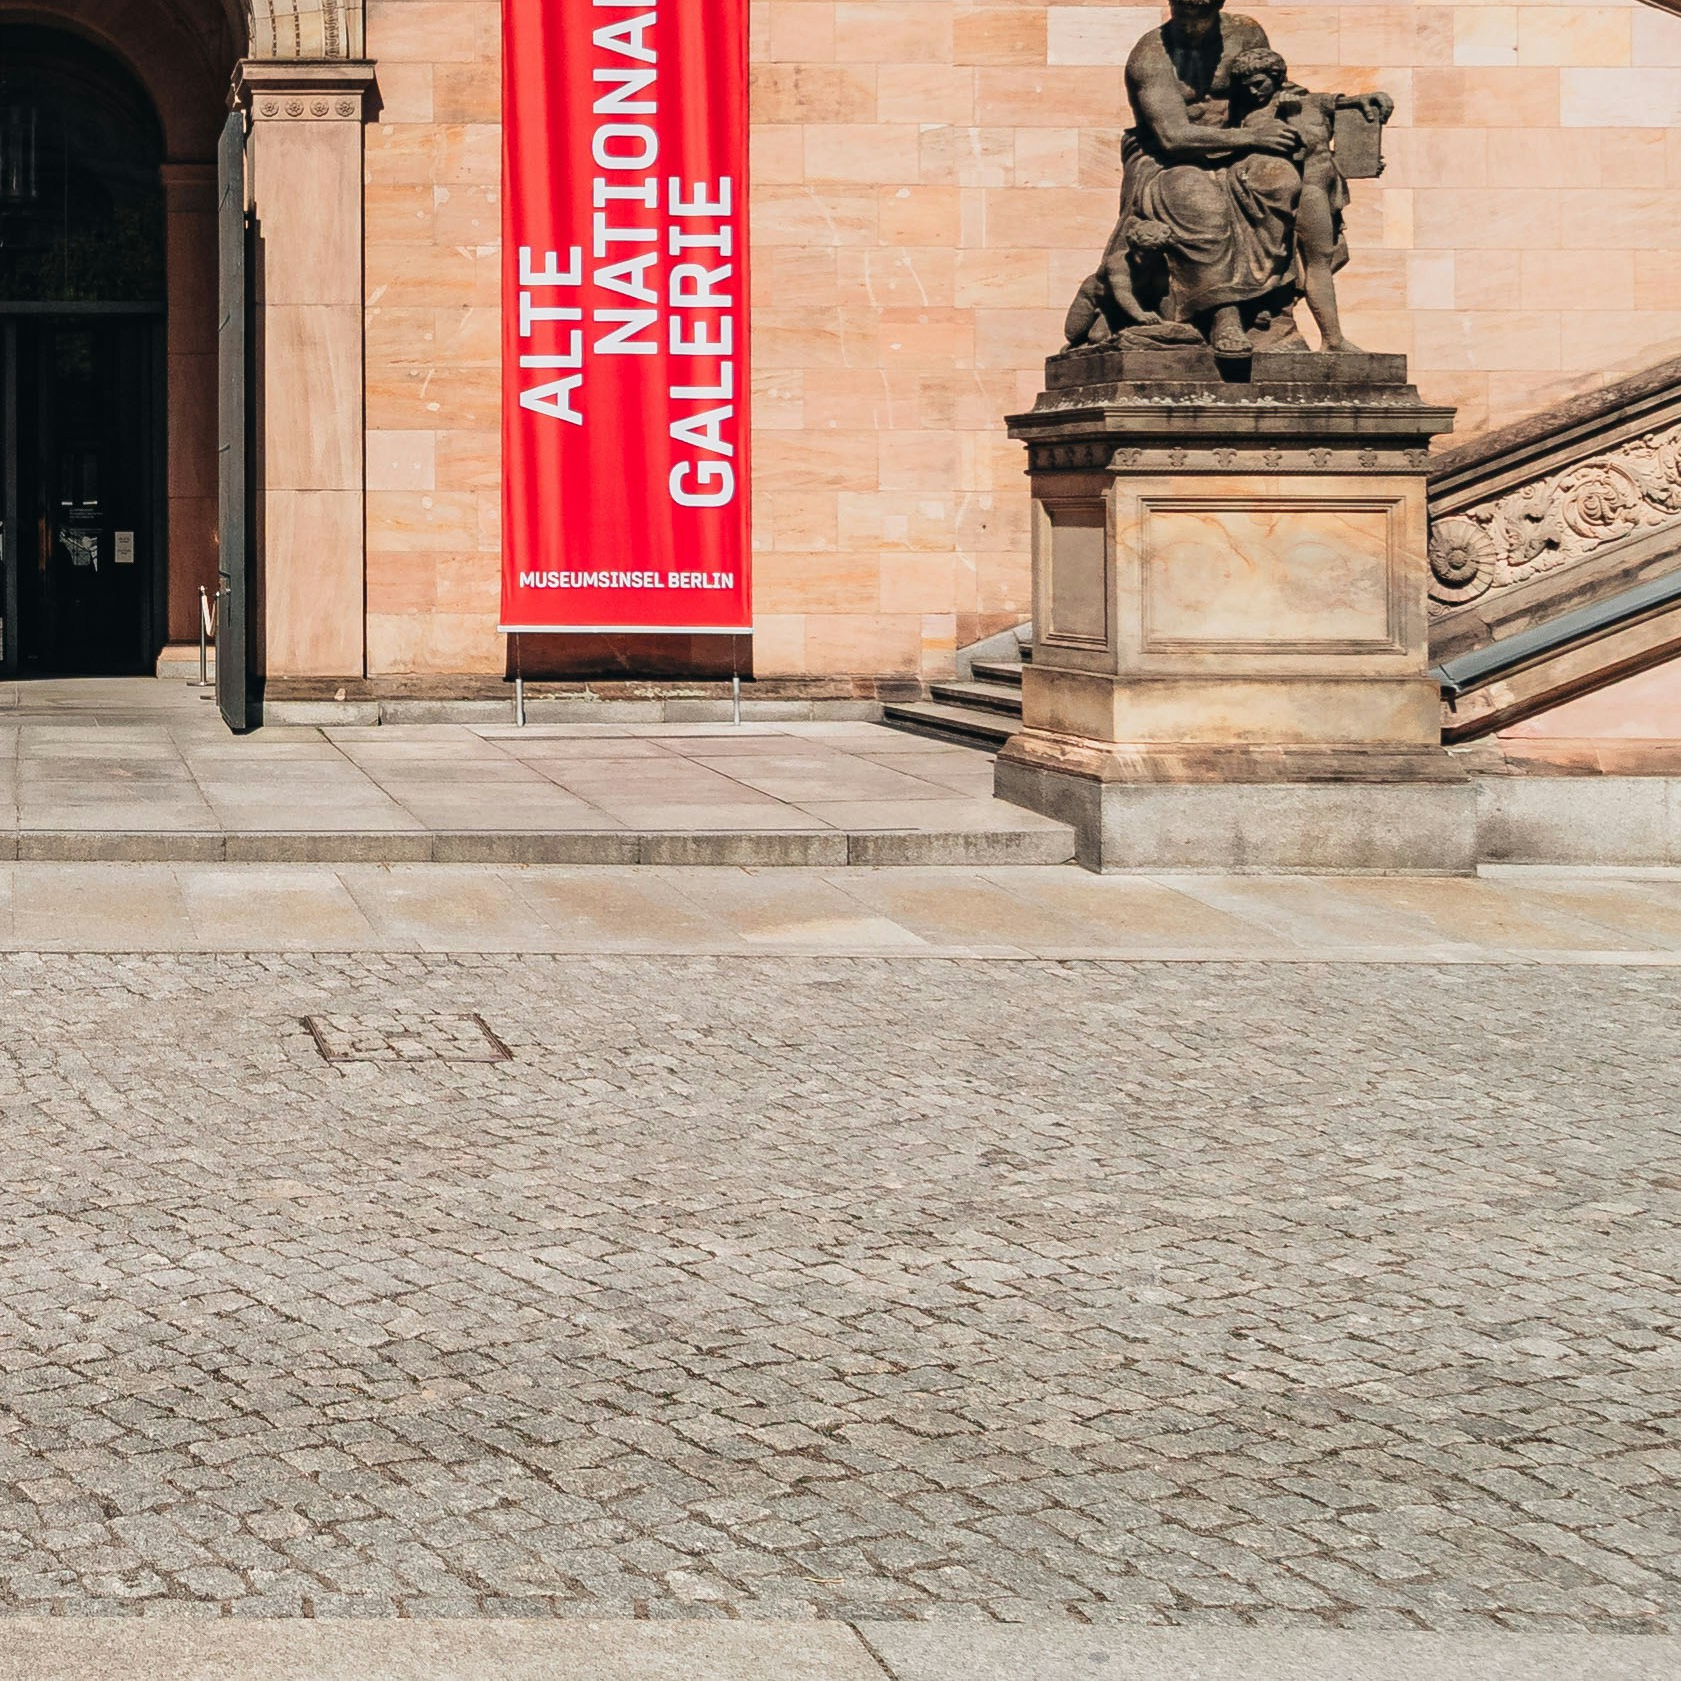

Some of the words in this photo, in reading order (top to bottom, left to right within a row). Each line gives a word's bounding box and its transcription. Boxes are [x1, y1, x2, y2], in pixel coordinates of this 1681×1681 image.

[519, 245, 583, 426] ALTE
[668, 175, 735, 508] GALERIE
[519, 571, 665, 589] MUSEUMSINSEL
[668, 571, 734, 589] BERLIN
